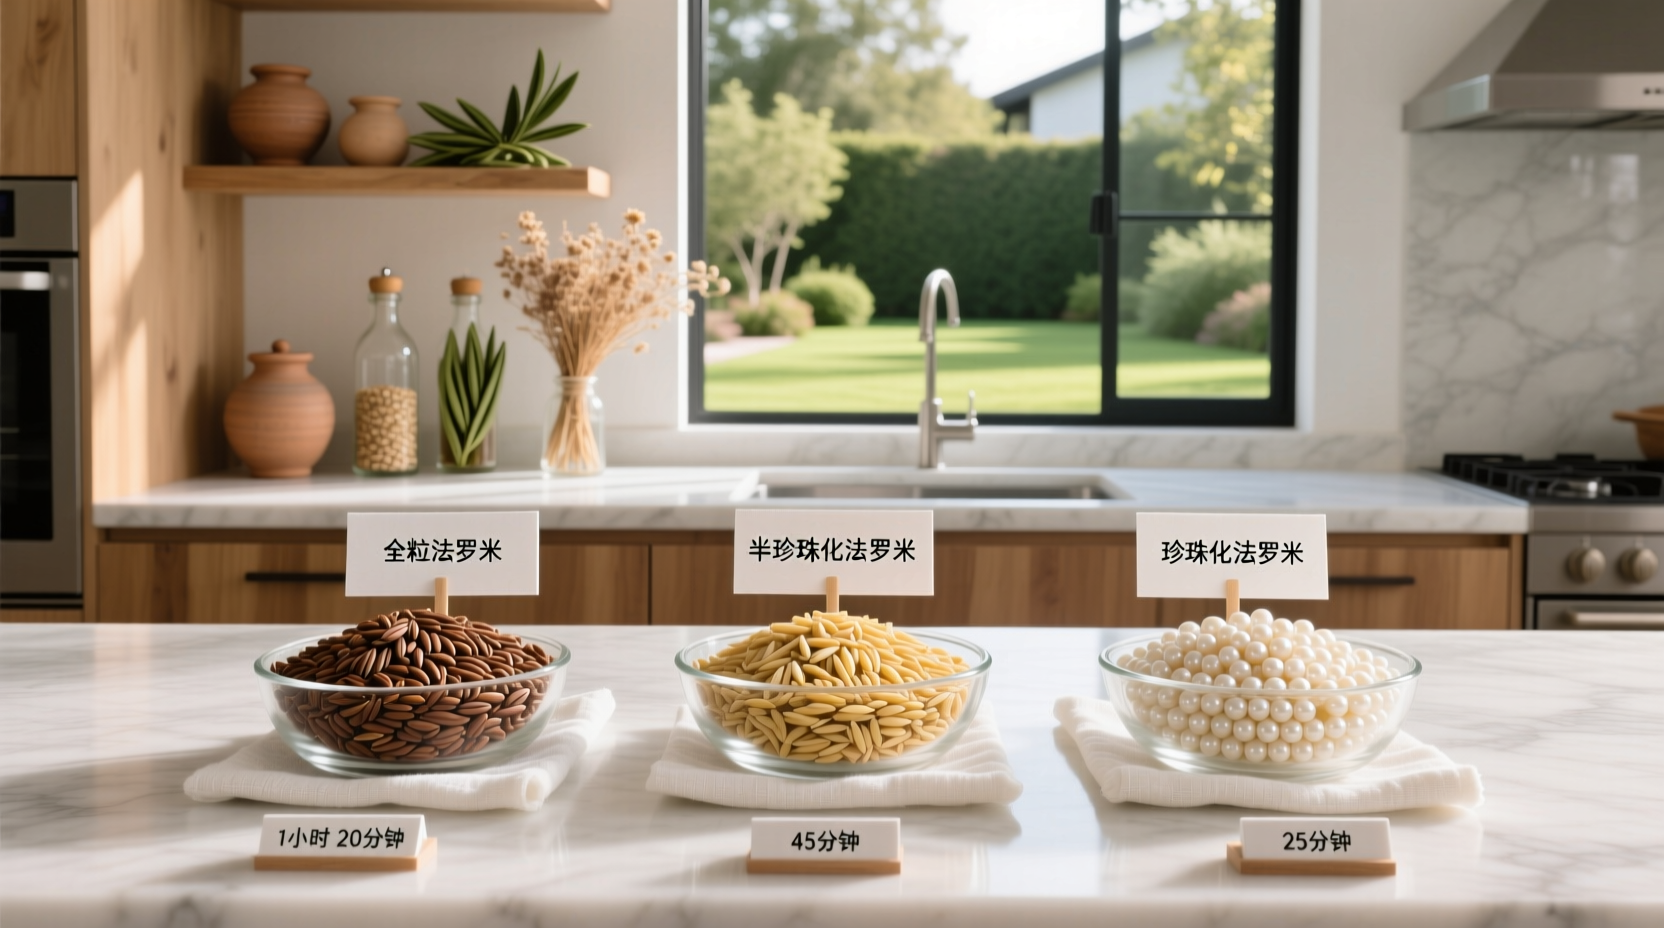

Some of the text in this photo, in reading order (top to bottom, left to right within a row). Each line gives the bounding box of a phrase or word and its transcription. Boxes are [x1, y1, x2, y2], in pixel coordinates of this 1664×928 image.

[384, 537, 502, 563] 全粒法罗米
[748, 535, 916, 563] 半珍珠化法罗米
[1161, 539, 1304, 566] 珍珠化法罗米
[279, 826, 405, 849] 1小时 20分钟
[791, 829, 860, 852] 45分钟
[1282, 829, 1352, 852] 25分钟
